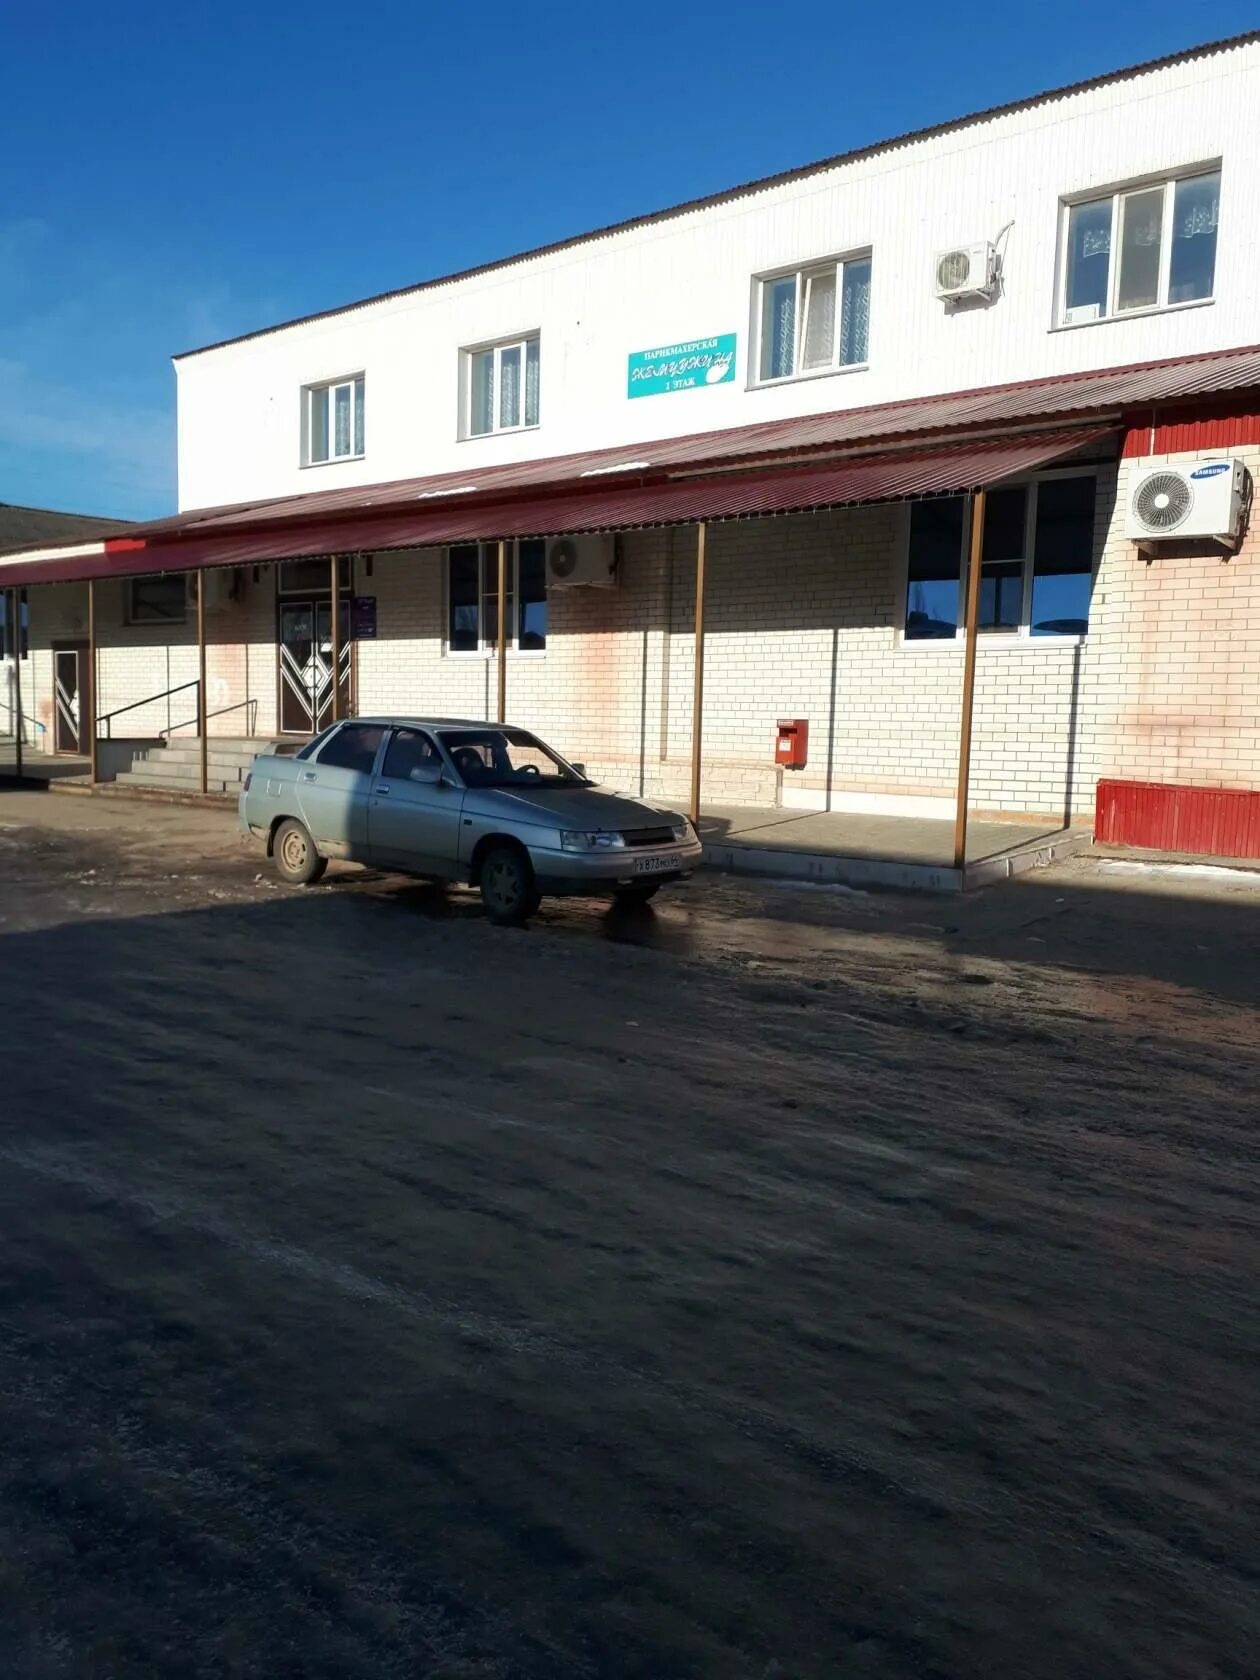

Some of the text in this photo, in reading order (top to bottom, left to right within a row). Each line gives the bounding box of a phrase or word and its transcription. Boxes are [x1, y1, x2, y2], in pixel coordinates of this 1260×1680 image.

[644, 338, 719, 361] ПАРИКМАХЕРСКАЯ
[665, 377, 696, 391] 1 ЭТАЖ
[1194, 467, 1227, 476] SAMSUNG
